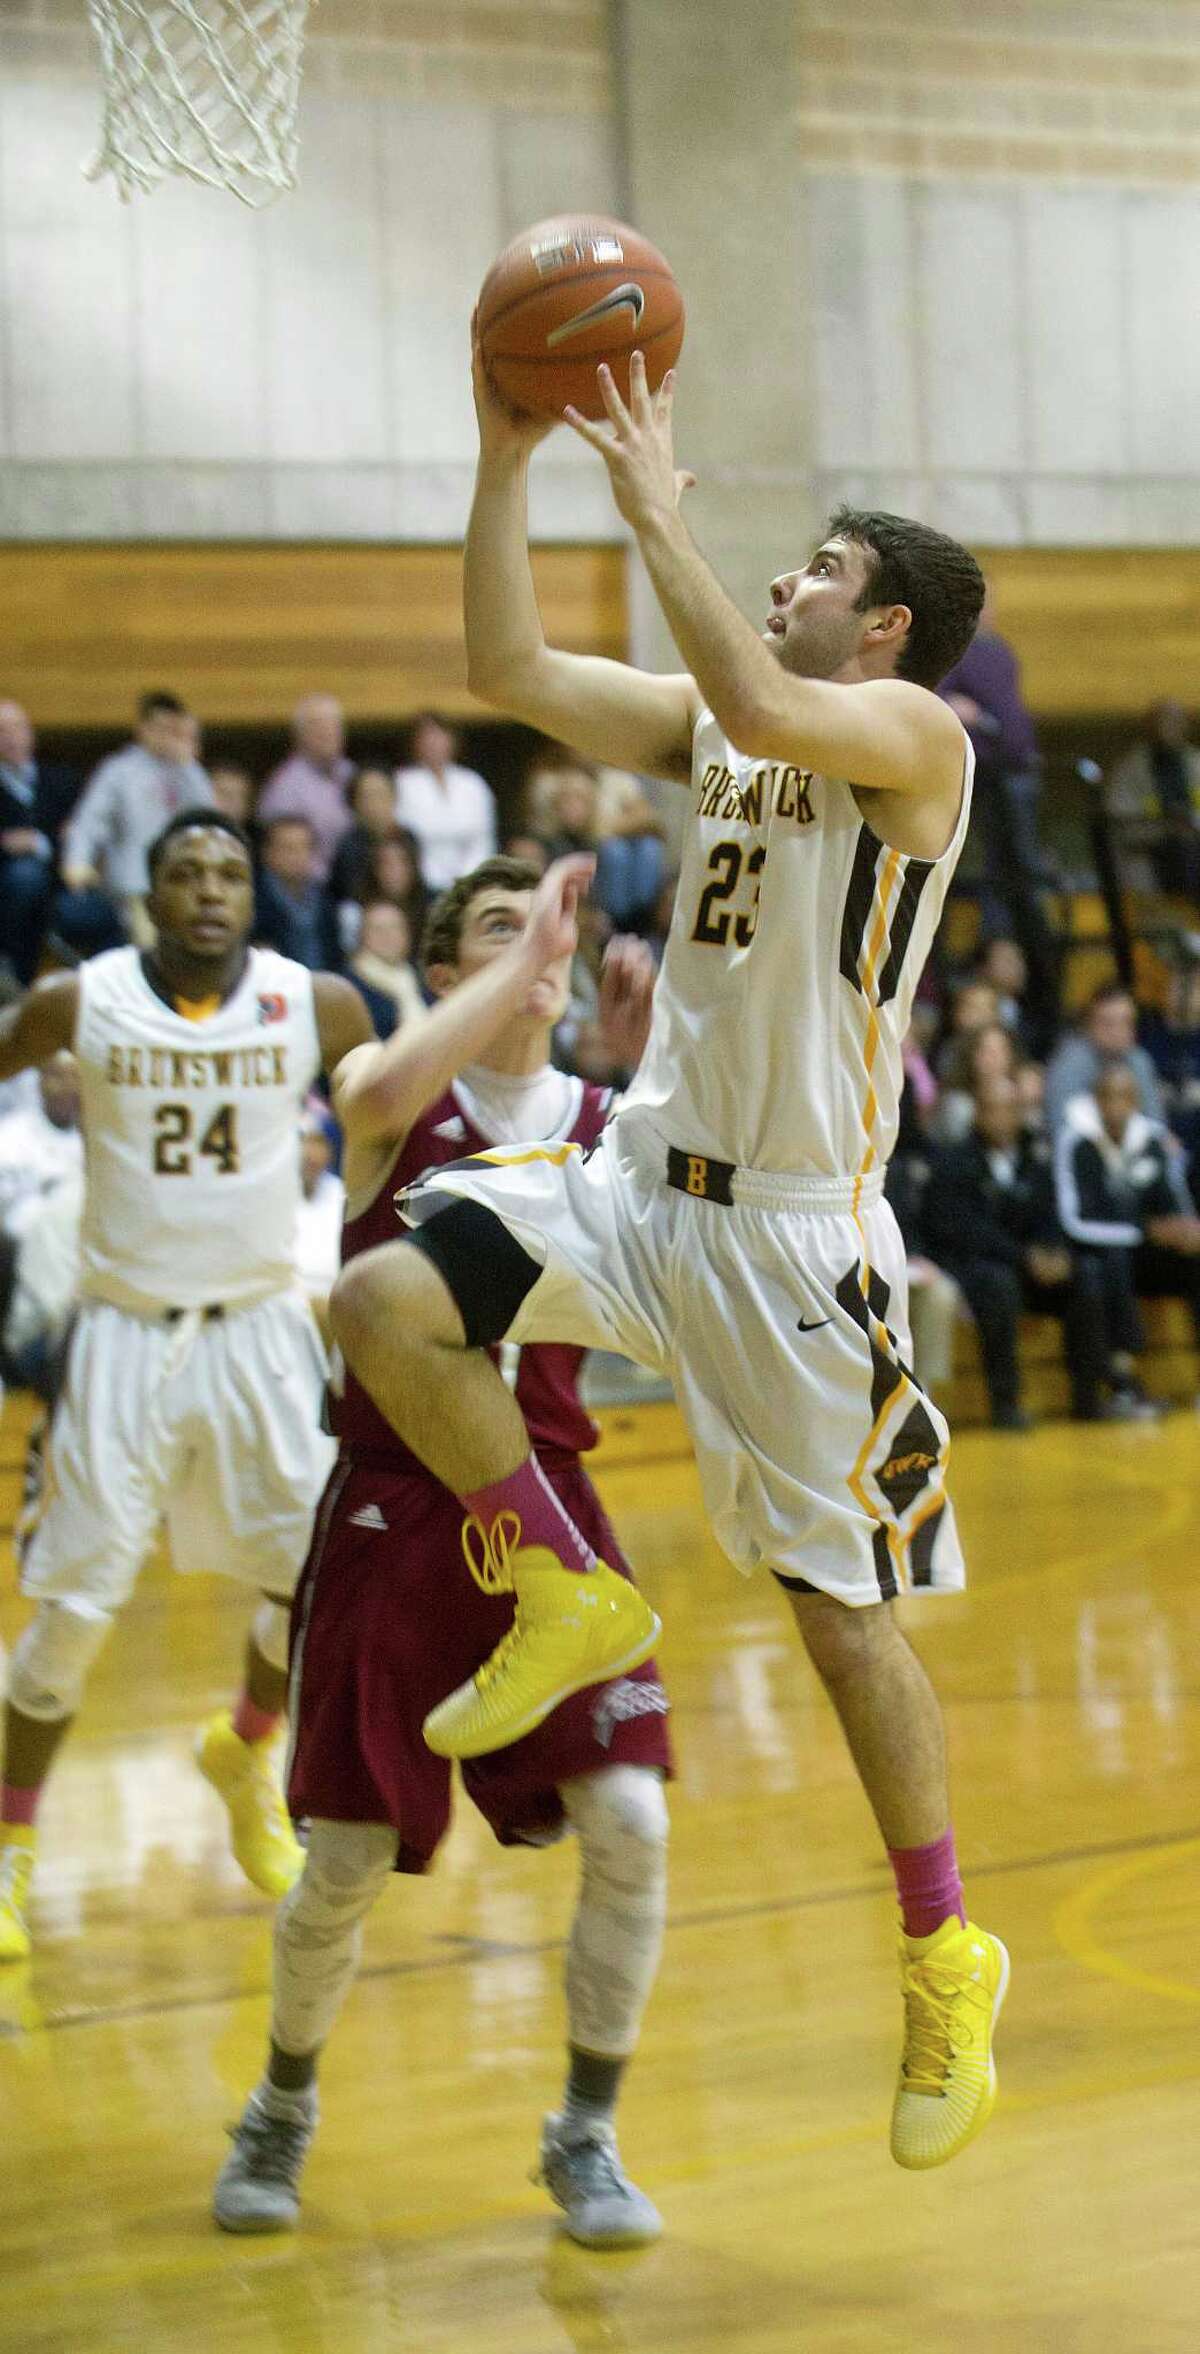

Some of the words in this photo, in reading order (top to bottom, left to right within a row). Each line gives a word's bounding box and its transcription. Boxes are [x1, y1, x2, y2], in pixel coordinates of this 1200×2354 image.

[691, 839, 767, 947] 23
[109, 1044, 285, 1088] BRUNSWICK
[153, 1103, 240, 1177] 24
[687, 1155, 707, 1197] B
